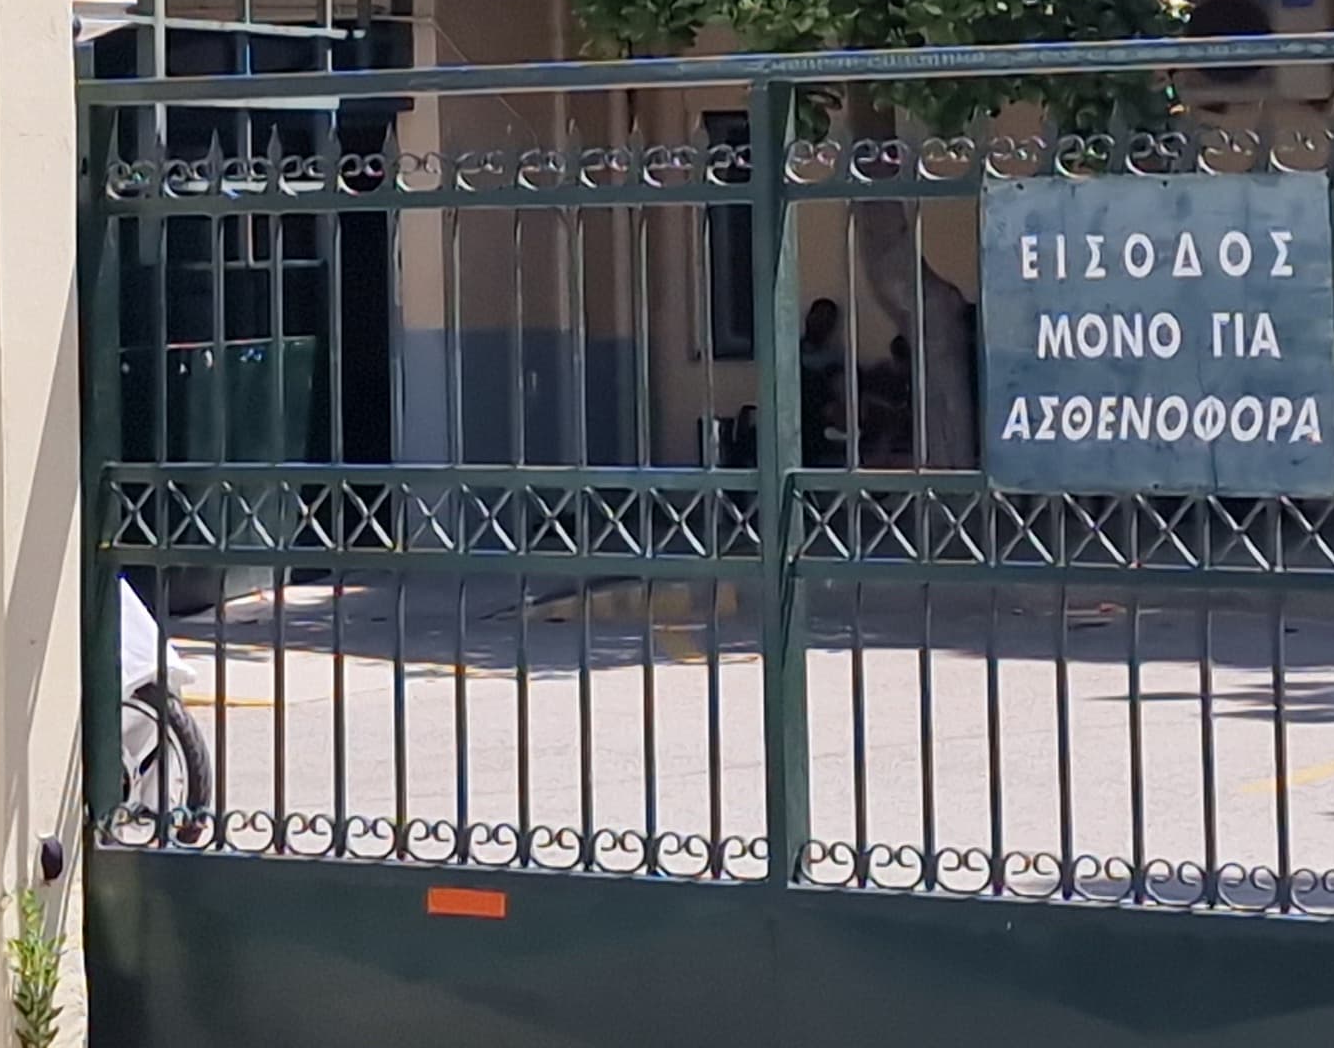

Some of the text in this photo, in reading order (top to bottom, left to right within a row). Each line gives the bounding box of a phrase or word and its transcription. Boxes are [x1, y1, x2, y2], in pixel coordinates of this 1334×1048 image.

[1019, 230, 1295, 280] ΕΙΣΟΔΟΣ
[1036, 311, 1282, 361] ΜΟΝΟ ΓΙΑ
[1000, 393, 1323, 444] ΑΣΘΕΝΟΦΟΡΑ
